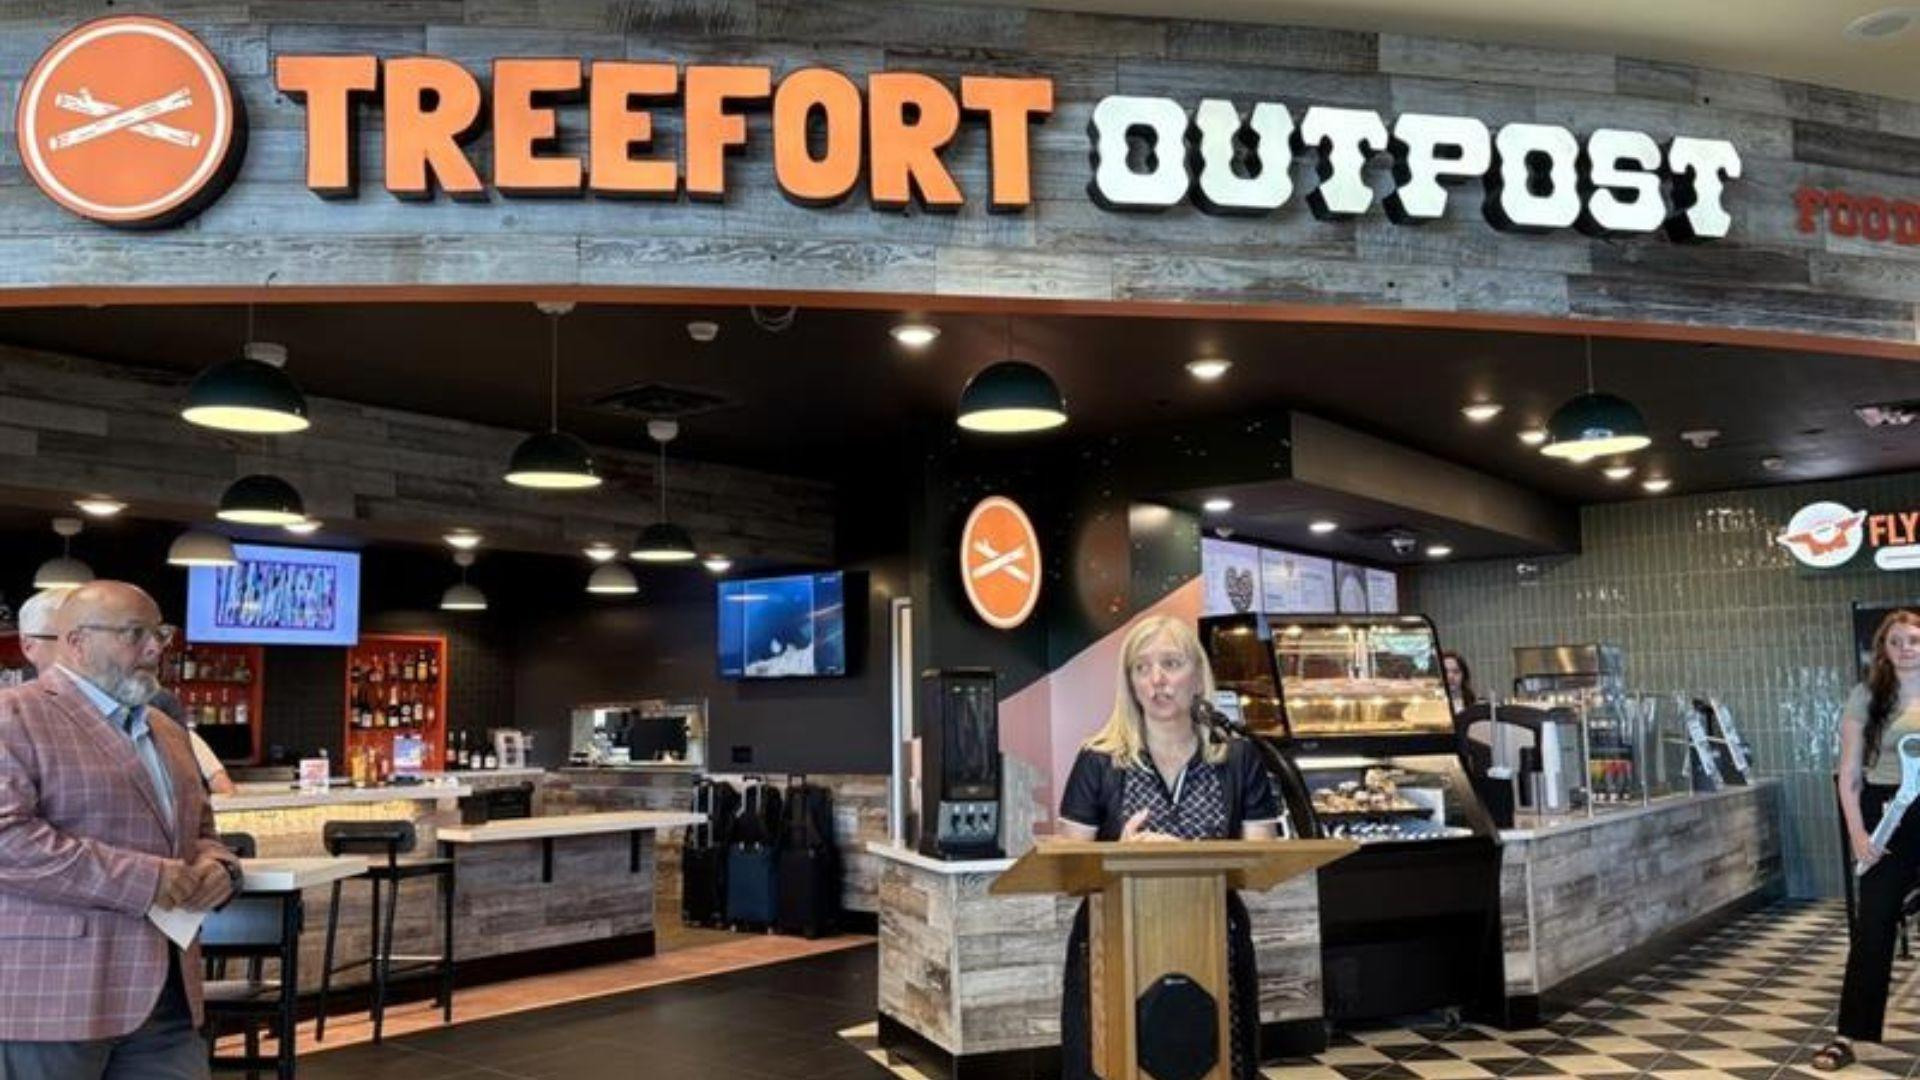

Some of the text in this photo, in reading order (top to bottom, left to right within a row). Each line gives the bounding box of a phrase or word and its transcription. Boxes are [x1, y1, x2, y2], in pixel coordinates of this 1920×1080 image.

[275, 54, 1742, 239] TREEFORT OUTPOST
[1795, 186, 1920, 244] FOOD
[1868, 512, 1919, 547] FLY
